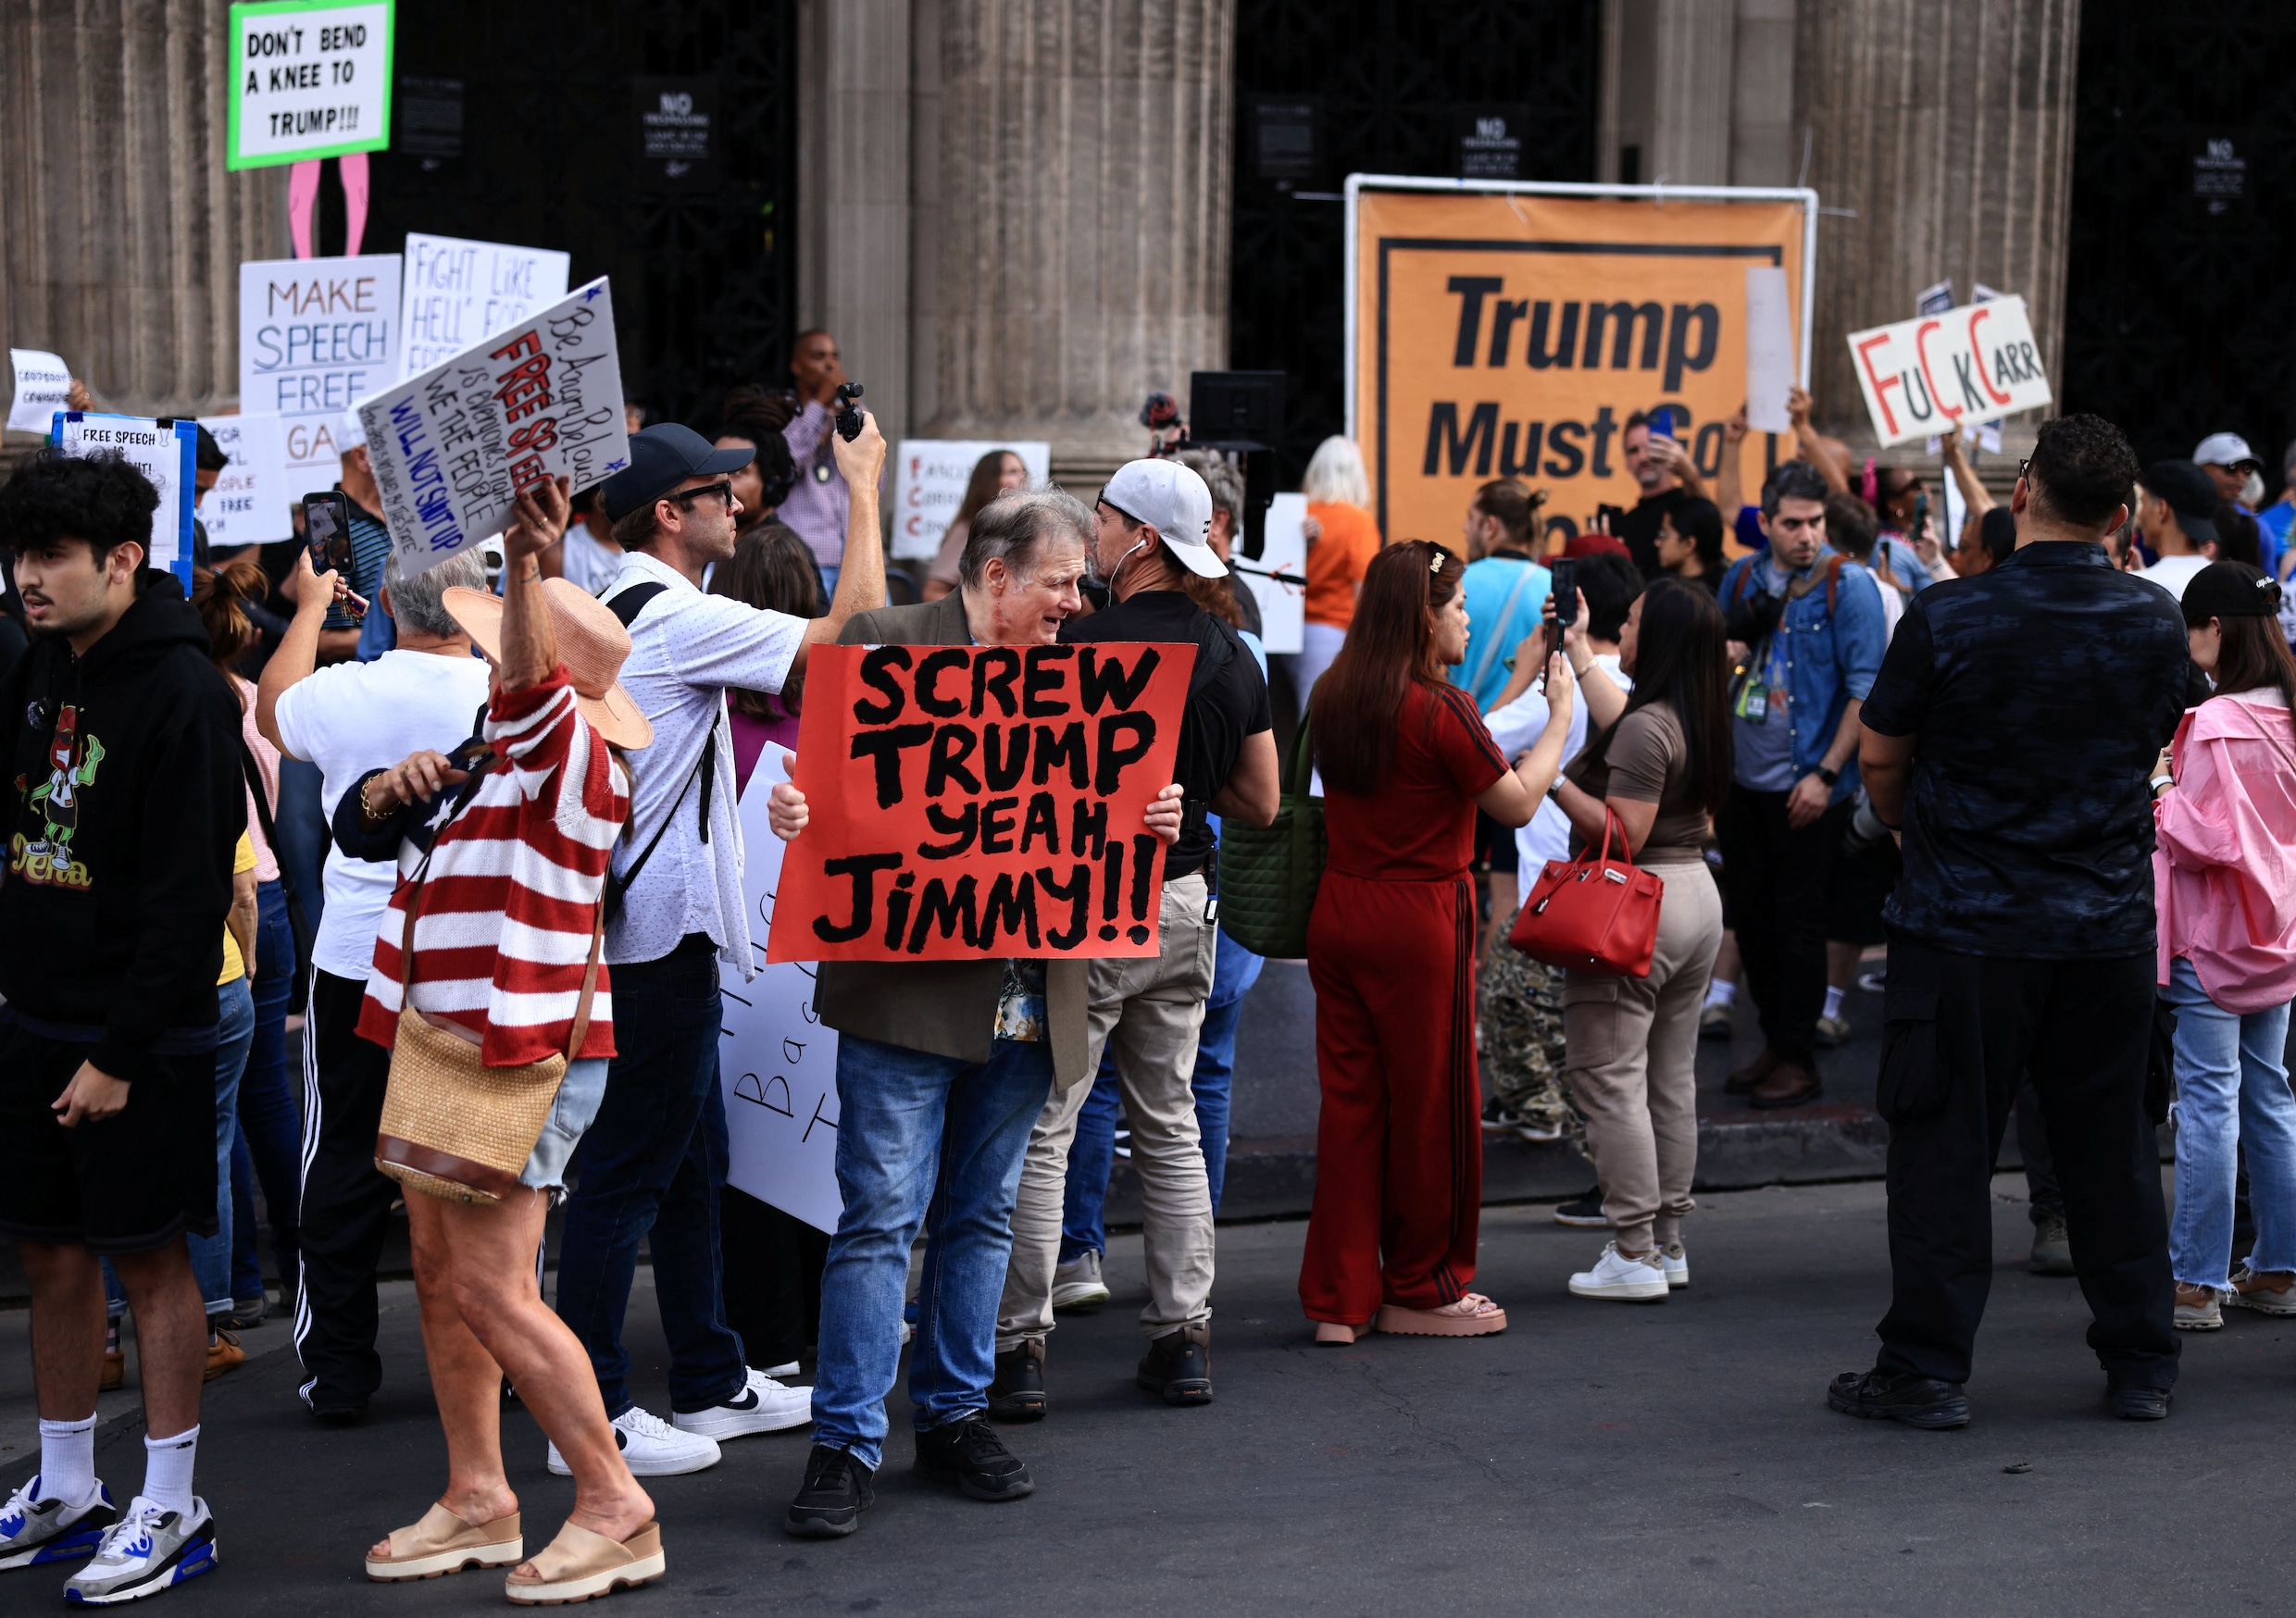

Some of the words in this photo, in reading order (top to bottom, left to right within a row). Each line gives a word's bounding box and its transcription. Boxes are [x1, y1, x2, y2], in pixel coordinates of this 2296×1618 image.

[247, 25, 304, 57] DON'T
[320, 24, 367, 52] BEND
[245, 70, 258, 95] A
[269, 63, 322, 93] KNEE
[331, 60, 355, 85] TO
[269, 106, 359, 137] TRUMP!!!
[268, 278, 378, 317] MAKE
[253, 319, 388, 369] SPEECH
[547, 306, 595, 351] Be
[1446, 275, 1721, 392] Trump
[425, 367, 457, 416] WE
[488, 330, 553, 425] FREE
[83, 429, 111, 442] FREE
[115, 430, 155, 445] SPEECH
[389, 395, 427, 457] WILL
[438, 409, 474, 452] THE
[1422, 402, 1618, 479] Must
[405, 447, 443, 492] NOT
[447, 449, 494, 529] PEOPLE
[430, 524, 464, 552] UP
[853, 644, 1161, 725] SCREW
[850, 711, 1156, 810] TRUMP
[917, 791, 1109, 861] YEAH
